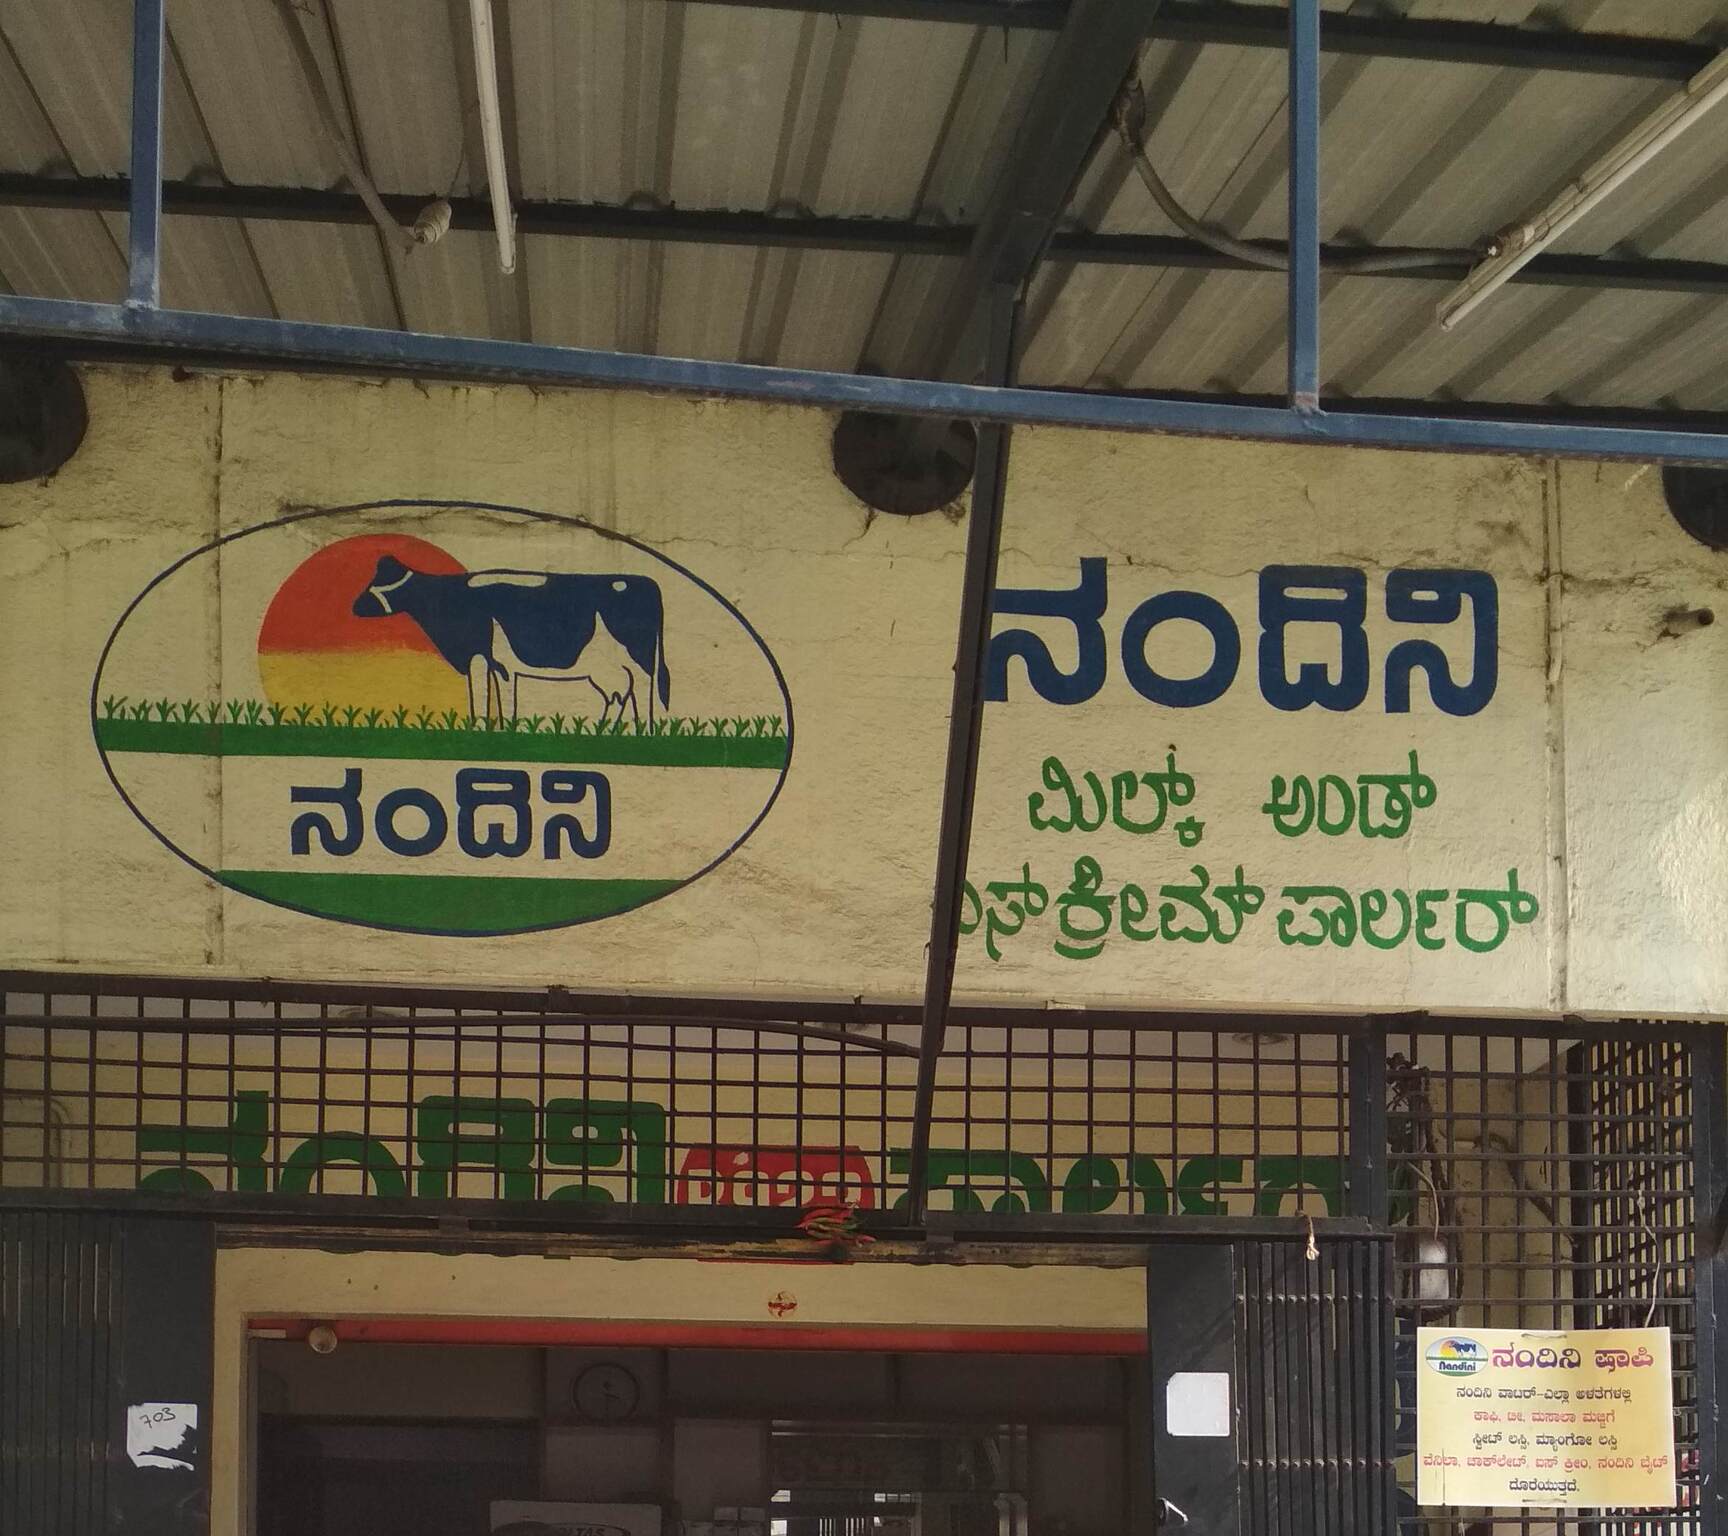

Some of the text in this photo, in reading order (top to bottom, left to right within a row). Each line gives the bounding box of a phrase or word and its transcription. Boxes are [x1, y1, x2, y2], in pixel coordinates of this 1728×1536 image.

[985, 557, 1499, 717] ನಂದಿನಿ
[1027, 749, 1438, 848] ಮಿಲ್ಕ್ ಅಂಡ್
[290, 767, 613, 861] ನಂದಿನಿ
[1277, 868, 1540, 953] ಪಾರ್ಲರ್
[1439, 1361, 1476, 1371] Nandini
[1492, 1342, 1654, 1373] ನಂದಿನಿ ಷಾಪಿ
[1457, 1386, 1492, 1398] ನಂದಿನಿ
[1575, 1387, 1632, 1404] ಅಳತೆಗಳಲ್ಲಿ
[139, 1407, 177, 1428] 703
[1531, 1411, 1576, 1423] ಮಸಾಲಾ
[1598, 1456, 1634, 1468] ನಂದಿನಿ
